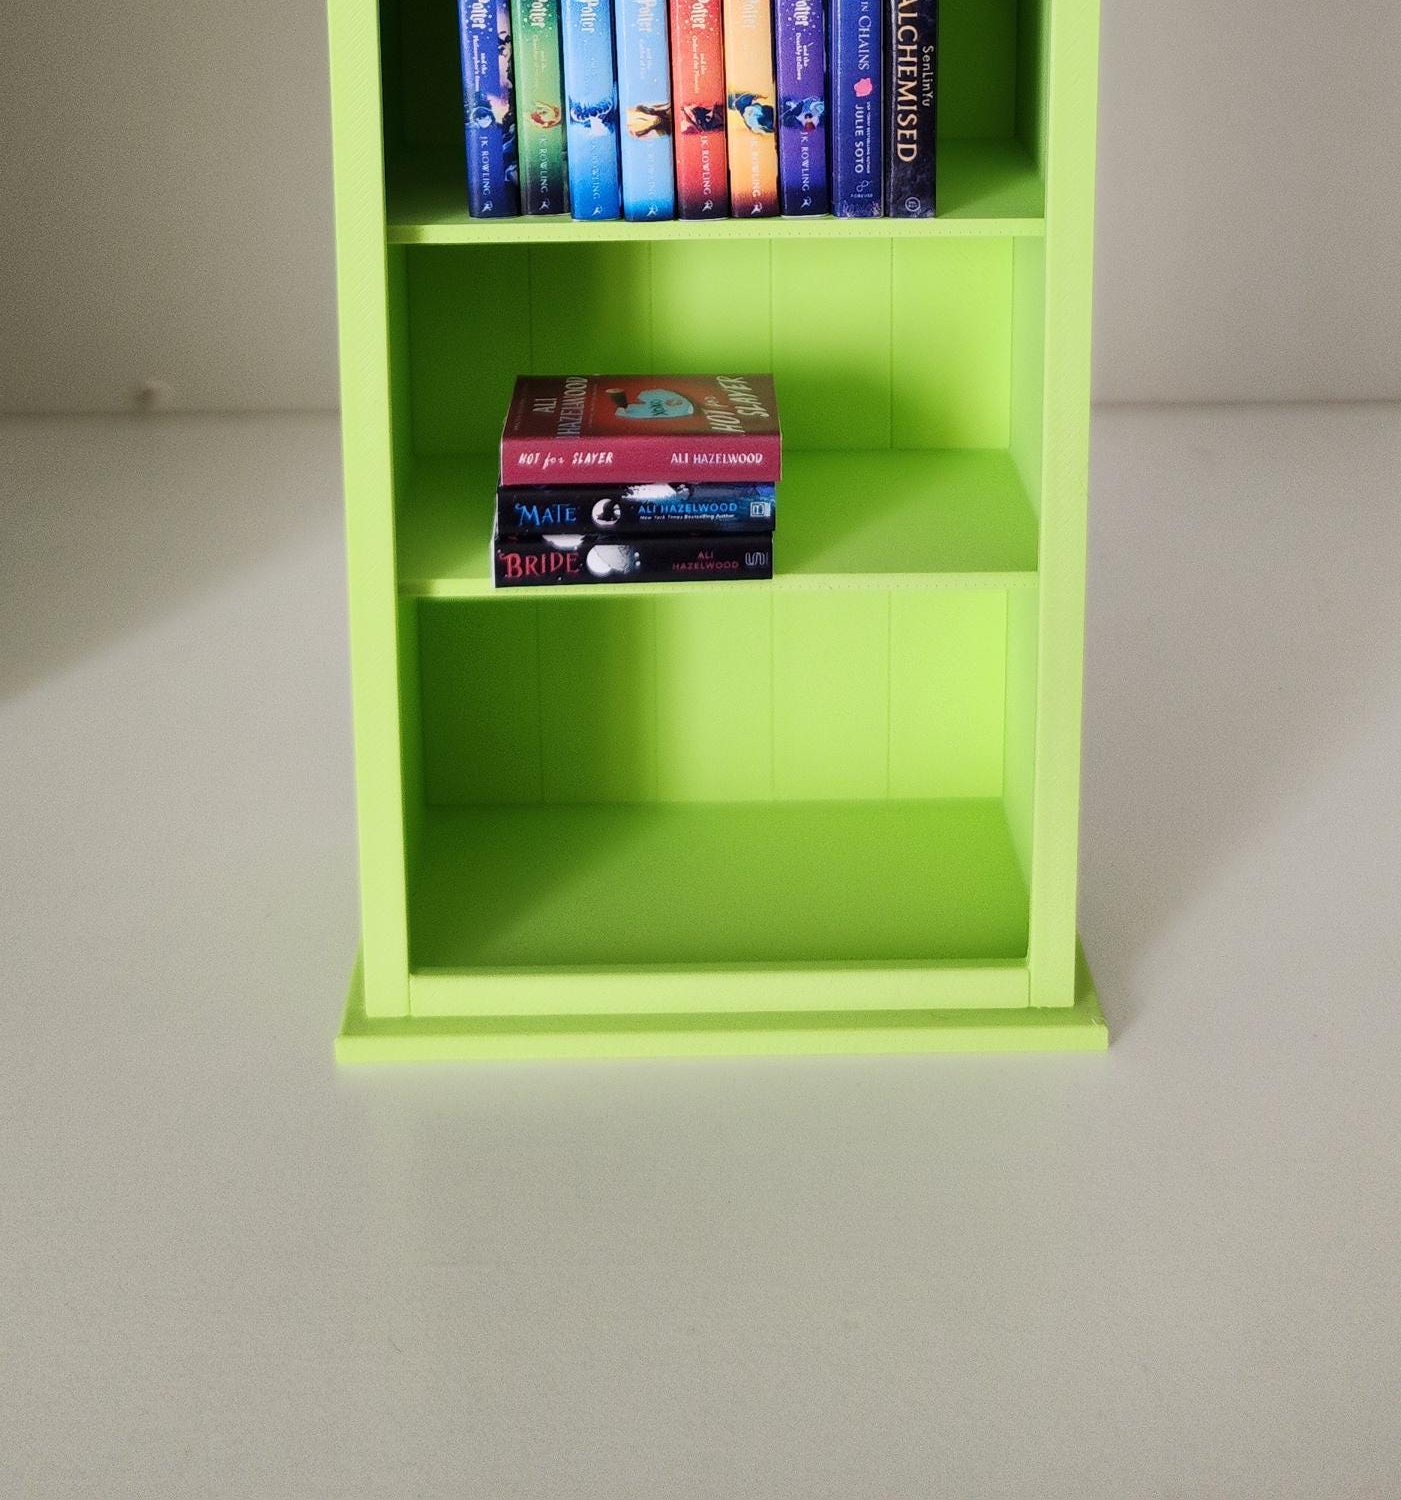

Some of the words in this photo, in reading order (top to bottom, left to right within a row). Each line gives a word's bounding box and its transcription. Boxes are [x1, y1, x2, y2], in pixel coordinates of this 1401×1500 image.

[860, 1, 869, 12] IN
[857, 16, 872, 70] CHAINS
[922, 45, 934, 107] SenLinYu
[854, 104, 864, 137] JULIE
[481, 150, 491, 196] ROWLING
[539, 148, 549, 194] ROWLING
[701, 149, 712, 196] ROWLING
[801, 146, 811, 192] ROWLING
[854, 141, 864, 174] SOTO
[532, 397, 558, 414] ALI
[556, 376, 589, 436] HAZELWOOD
[716, 375, 771, 418] SLAYER
[702, 407, 747, 436] HOT
[518, 452, 540, 466] HOT
[542, 452, 565, 470] for
[572, 451, 614, 465] SLAYER
[670, 452, 688, 464] ALI
[692, 452, 764, 465] HAZELWOOD
[514, 502, 577, 528] MATE
[638, 504, 656, 514] ALI
[660, 502, 738, 514] HAZELWOOD
[498, 550, 581, 579] BRIDE
[672, 561, 740, 570] HAZELWOOD
[697, 551, 714, 559] ALI
